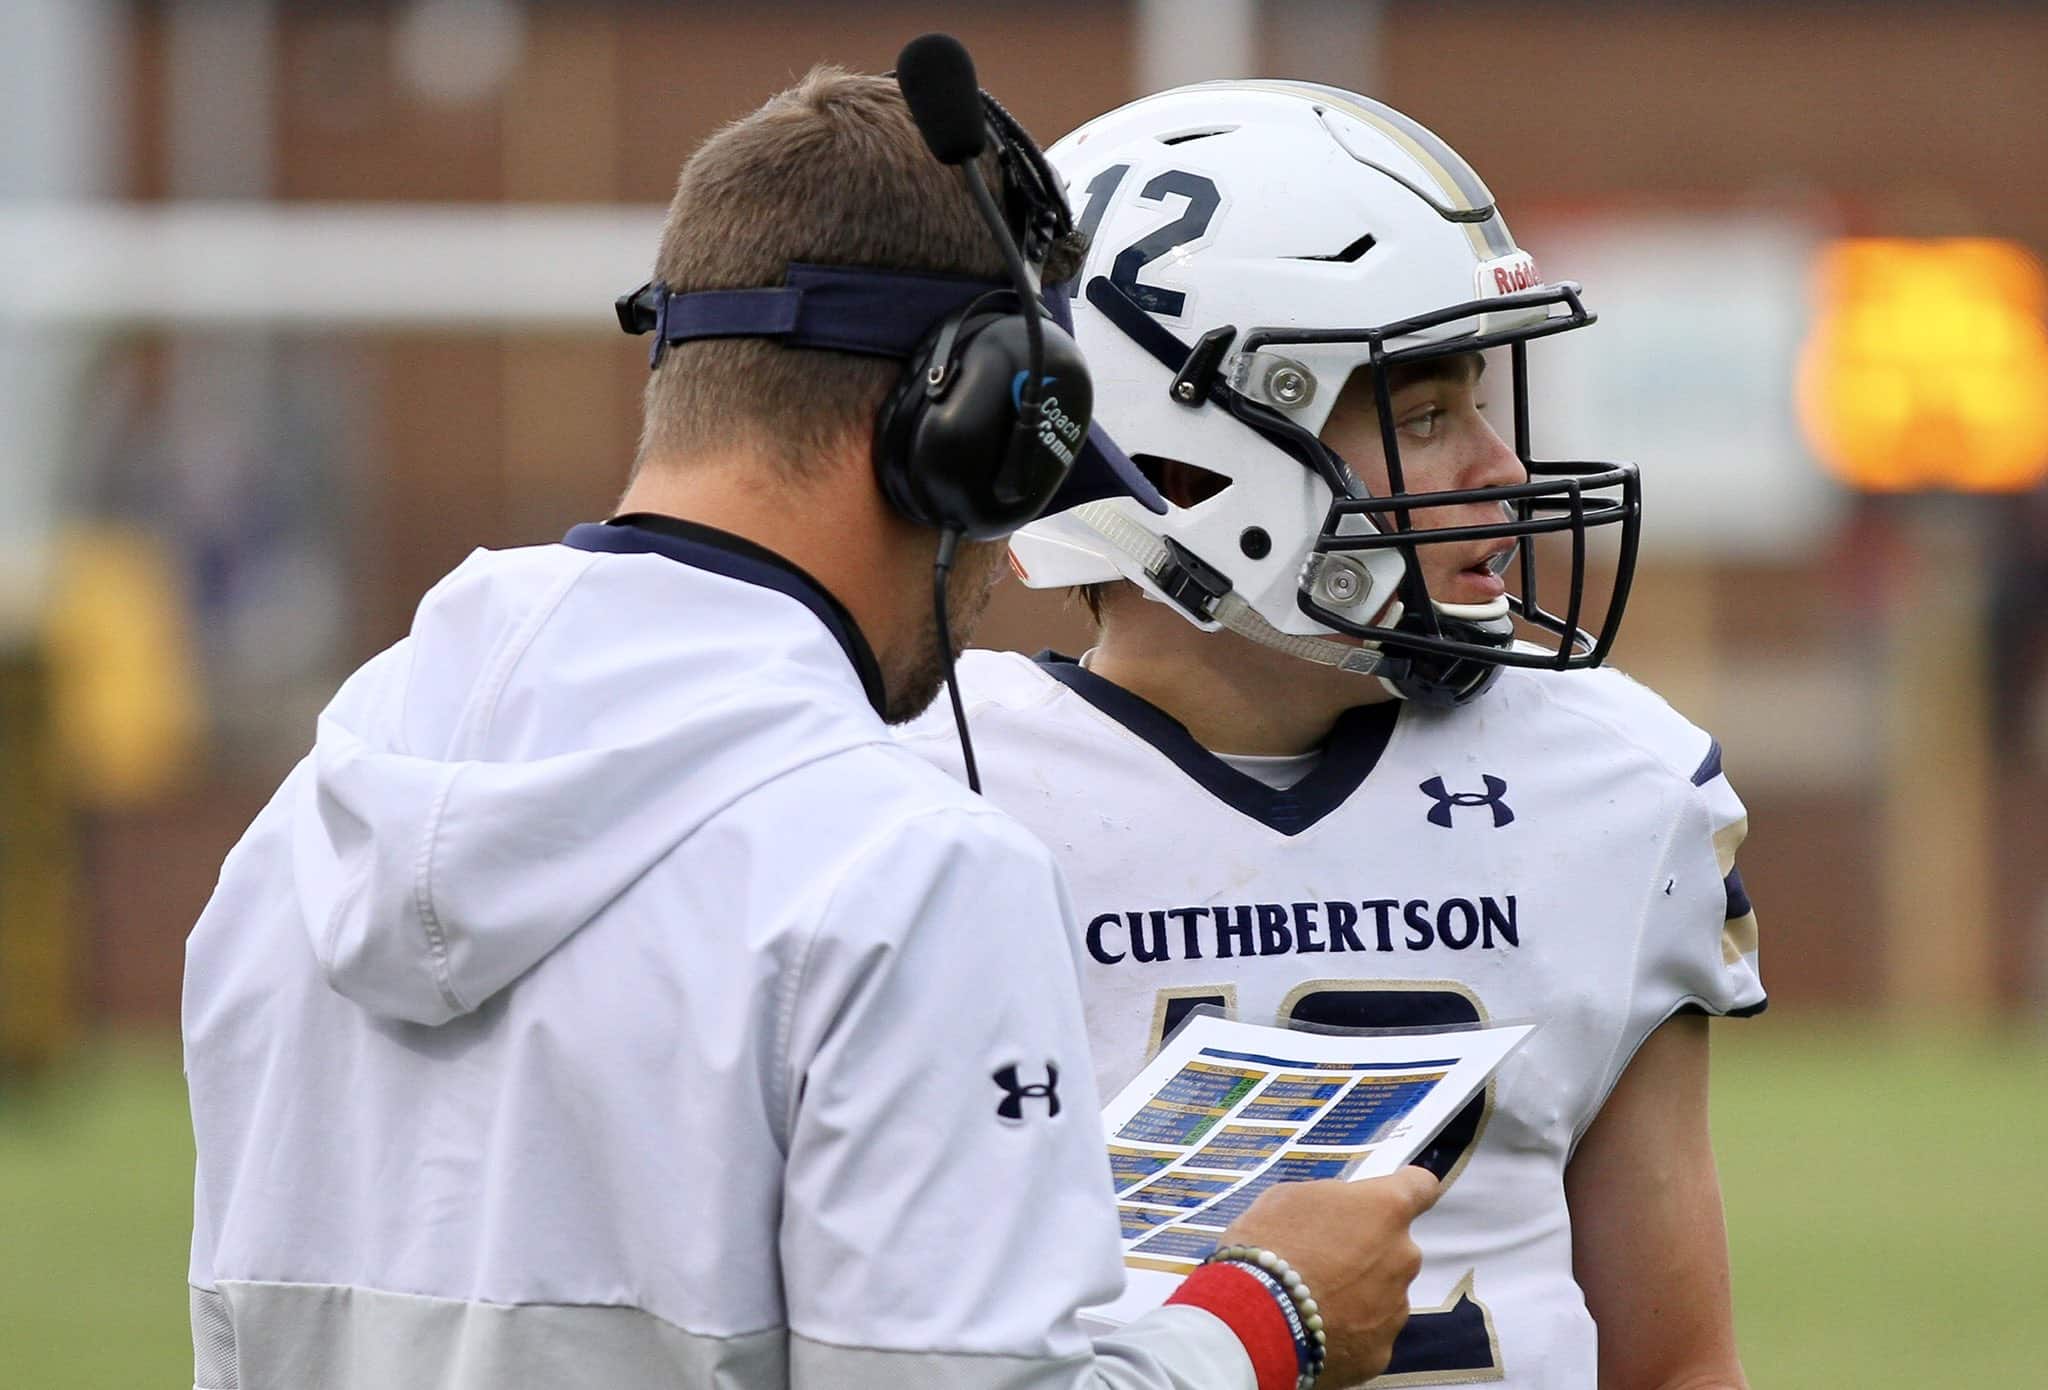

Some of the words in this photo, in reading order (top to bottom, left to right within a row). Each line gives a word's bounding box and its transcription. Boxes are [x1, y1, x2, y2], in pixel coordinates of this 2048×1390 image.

[1070, 164, 1222, 318] 12
[1041, 396, 1082, 442] Coach
[1085, 895, 1520, 965] CUTHBERTSON
